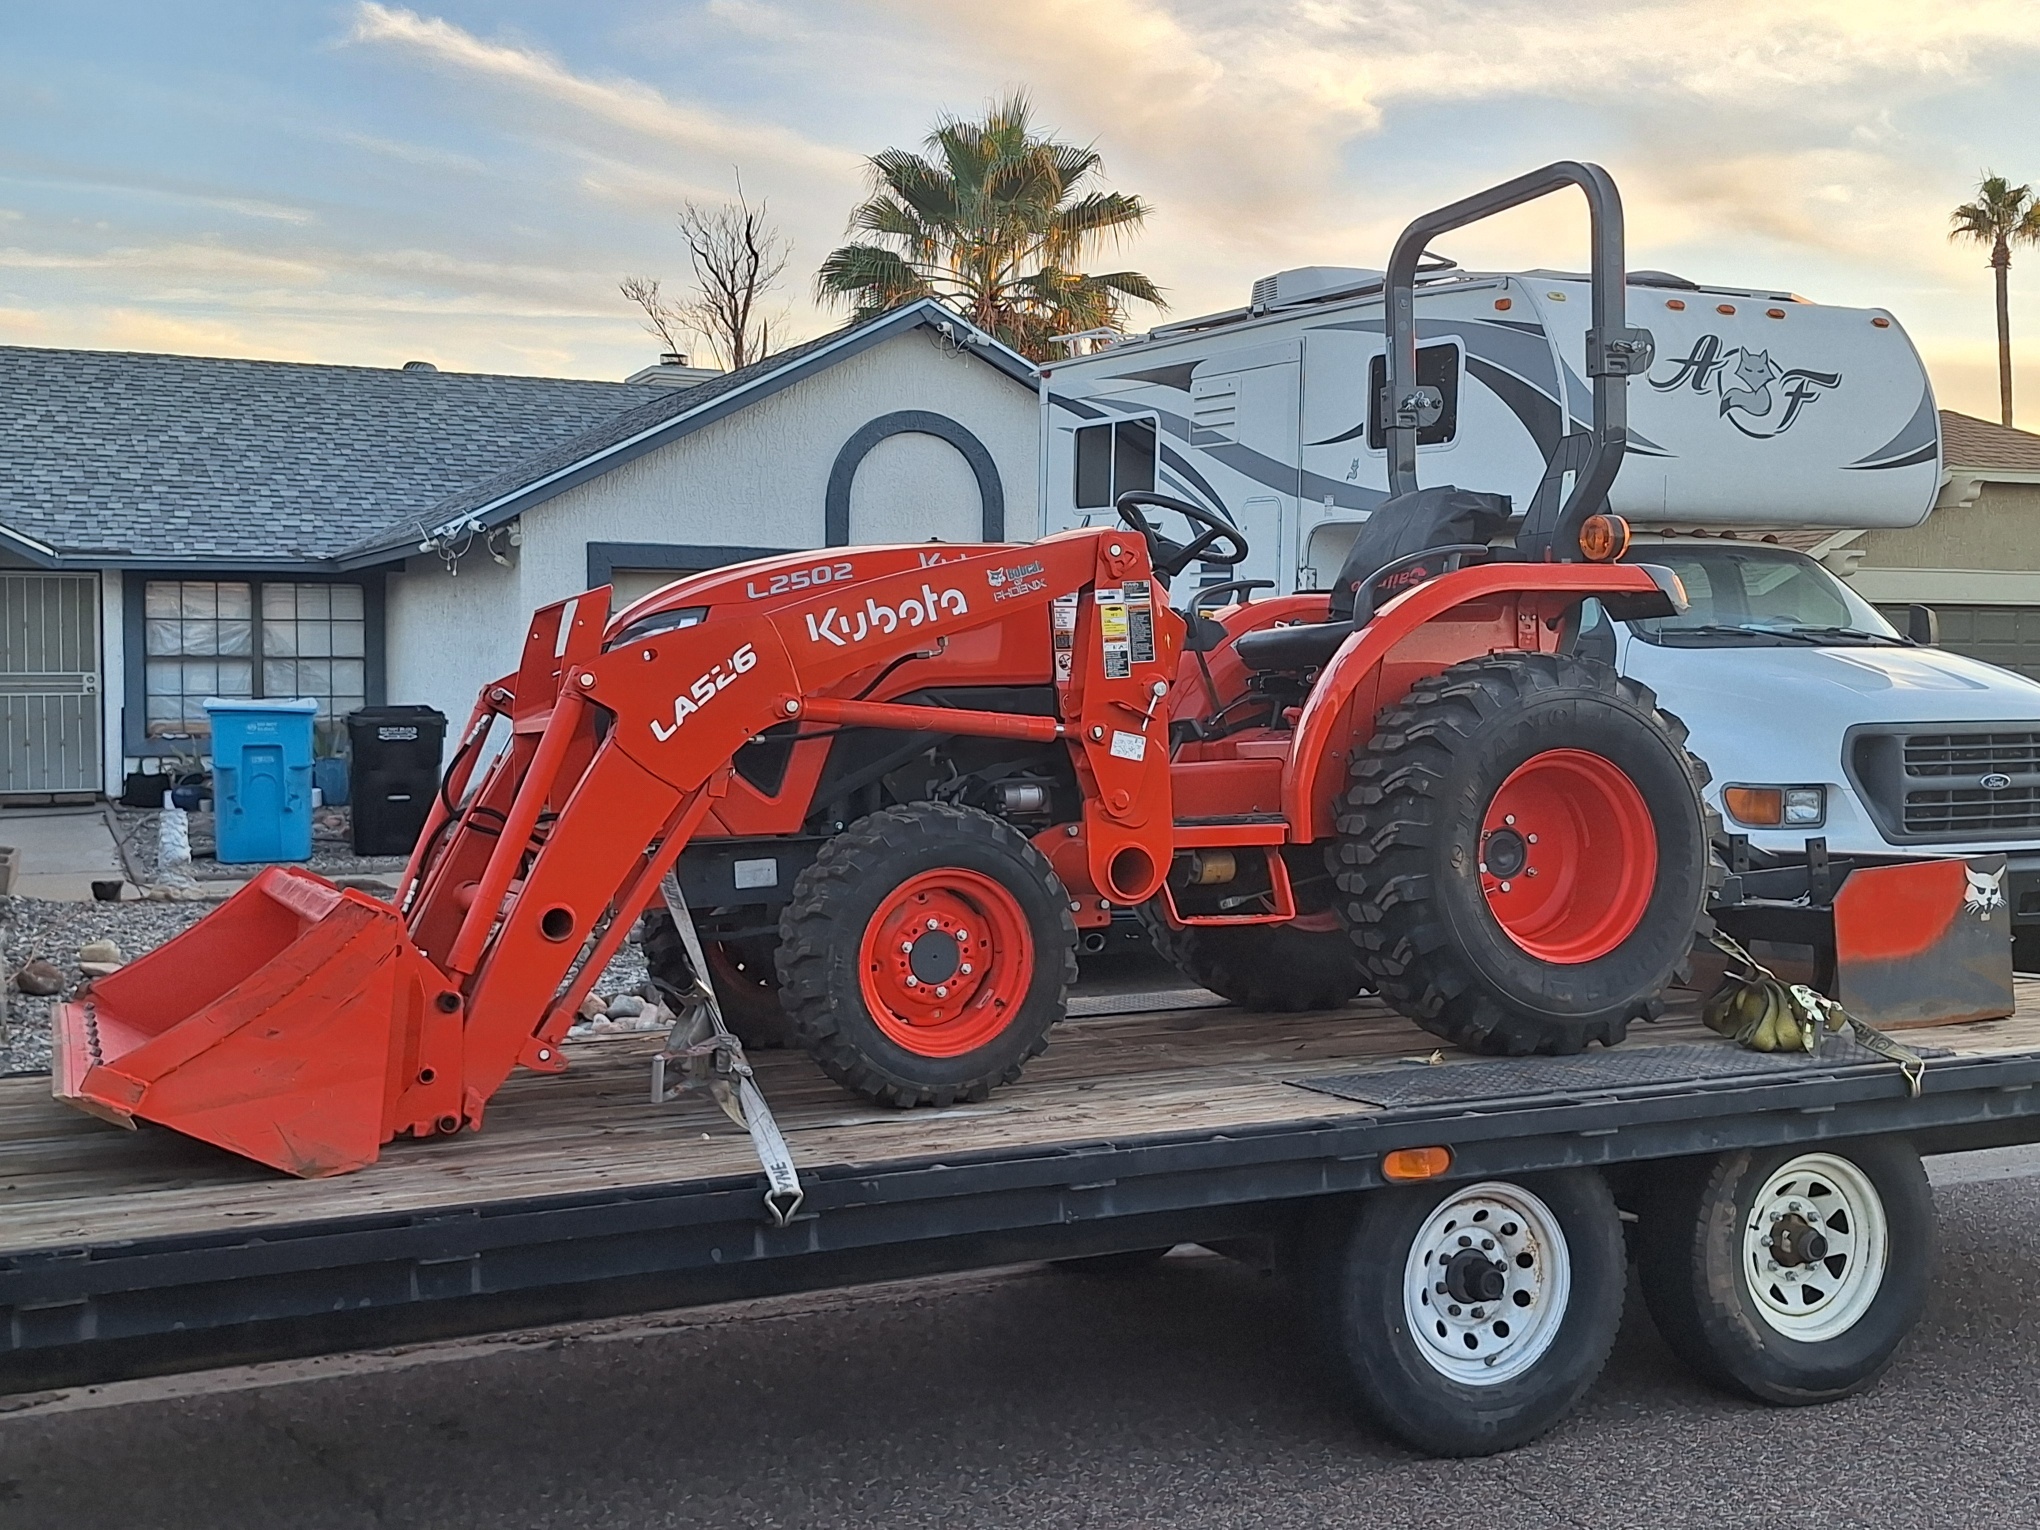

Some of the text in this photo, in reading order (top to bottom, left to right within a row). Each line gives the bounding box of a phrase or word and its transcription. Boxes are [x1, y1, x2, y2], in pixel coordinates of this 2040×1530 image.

[747, 562, 853, 599] L2502
[1006, 560, 1044, 581] Bobcat
[993, 578, 1048, 602] PHOENIX
[805, 584, 968, 646] Kubota
[650, 642, 757, 742] LA526
